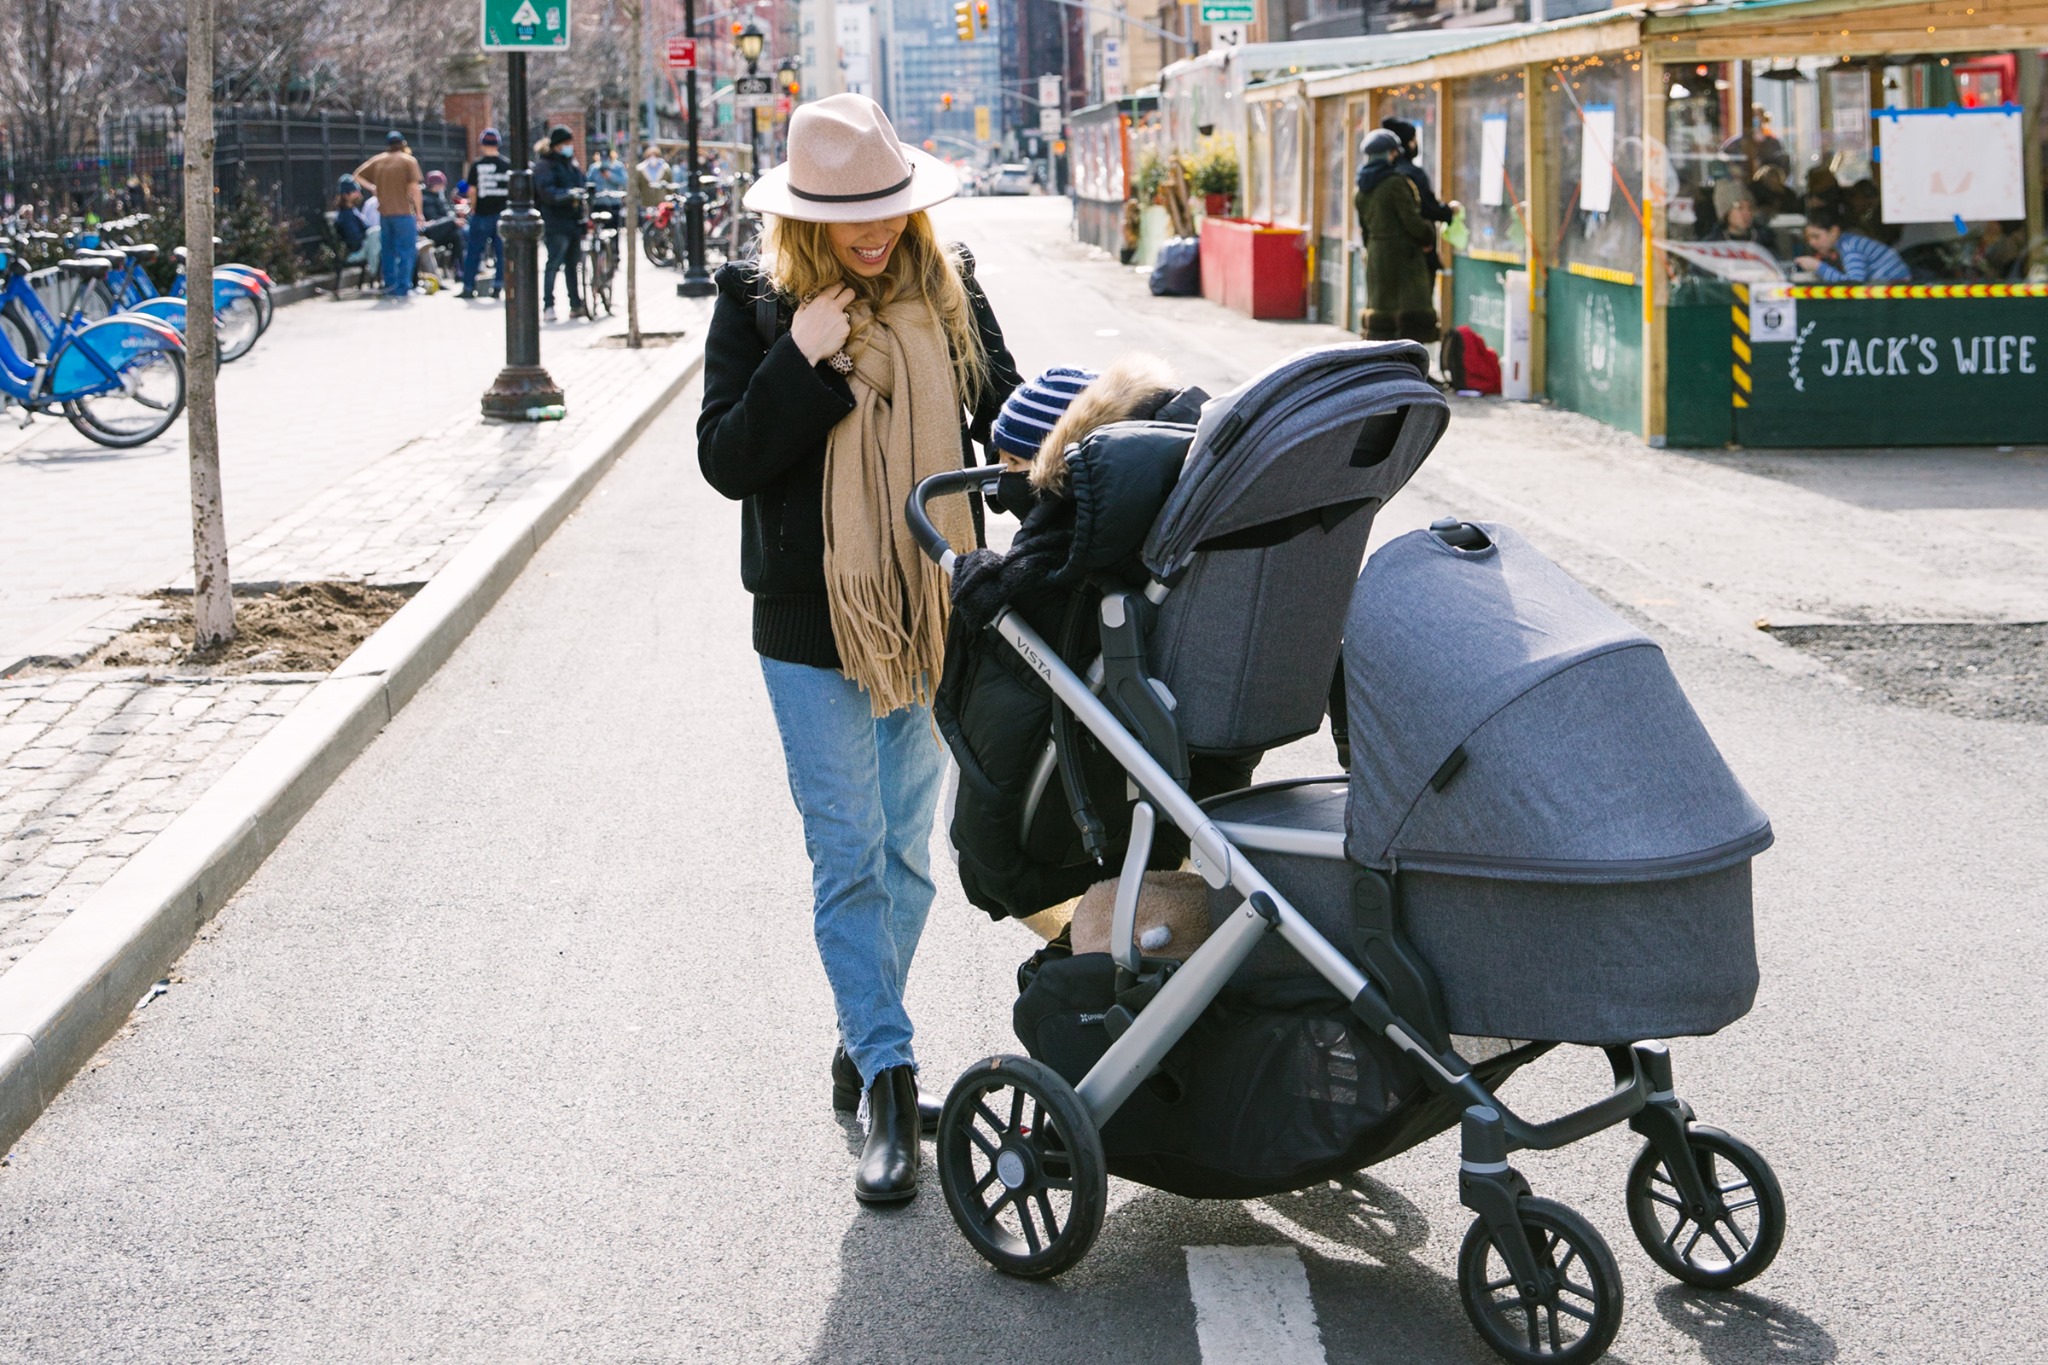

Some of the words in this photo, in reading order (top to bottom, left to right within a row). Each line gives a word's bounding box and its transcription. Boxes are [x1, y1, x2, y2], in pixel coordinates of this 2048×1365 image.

[1821, 334, 1938, 376] JACK'S
[1951, 335, 2036, 374] WIFE
[1017, 636, 1051, 680] VISTA
